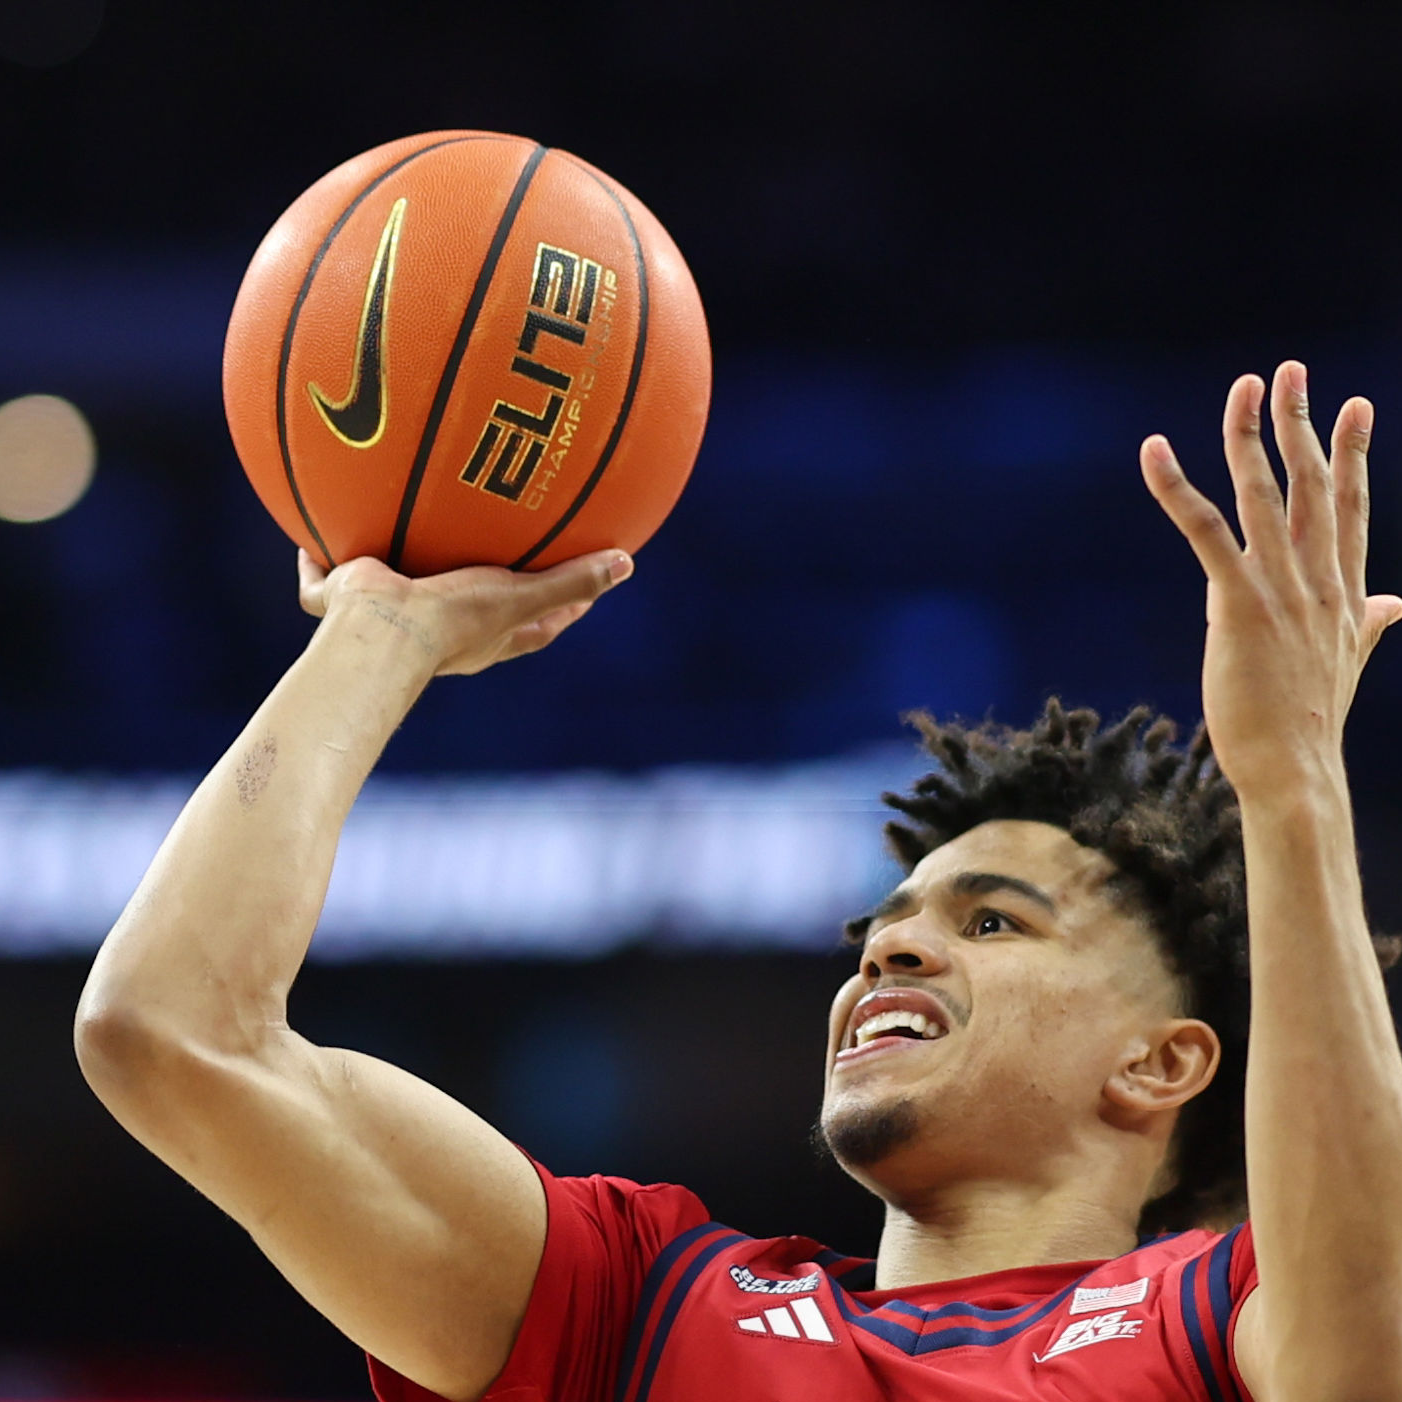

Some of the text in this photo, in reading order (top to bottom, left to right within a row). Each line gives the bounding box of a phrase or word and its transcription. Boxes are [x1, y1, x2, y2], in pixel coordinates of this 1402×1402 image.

[458, 241, 603, 505] ELITE
[1047, 1318, 1144, 1354] EAST
[1058, 1309, 1129, 1342] BIG
